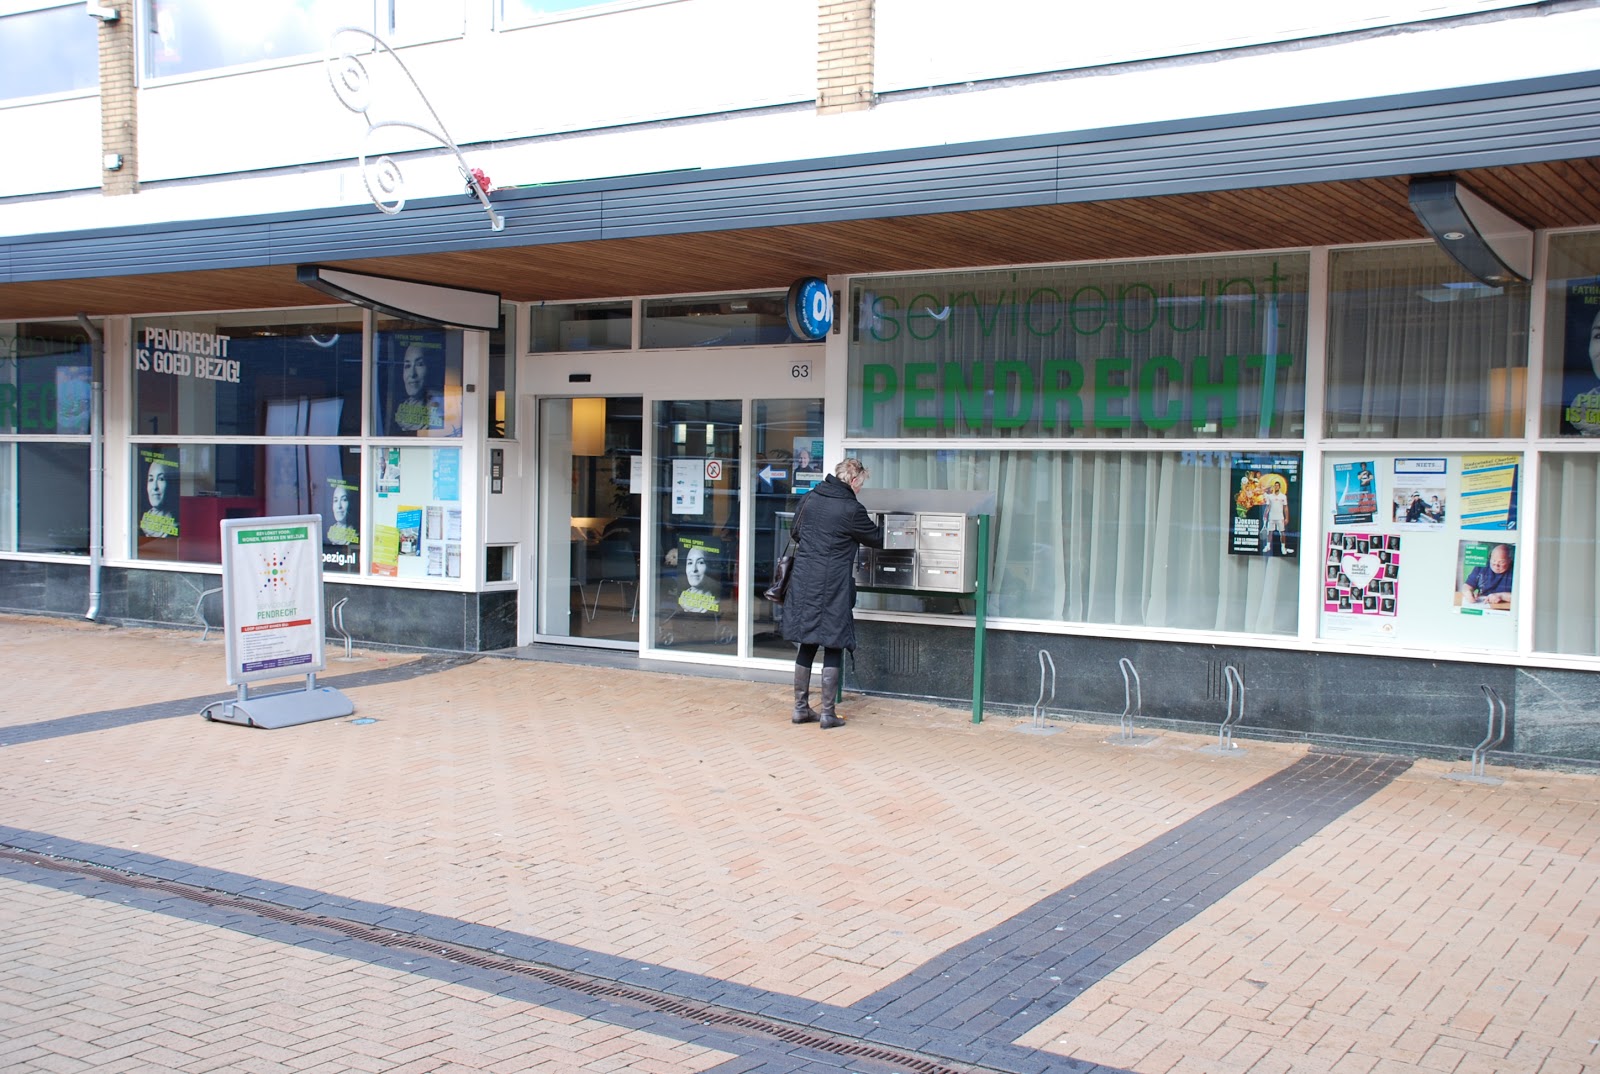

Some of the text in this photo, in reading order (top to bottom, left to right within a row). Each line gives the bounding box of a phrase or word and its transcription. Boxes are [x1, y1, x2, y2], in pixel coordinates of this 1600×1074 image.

[870, 262, 1288, 349] servicepunt
[1584, 296, 1600, 304] ME
[145, 327, 230, 358] PENDRECHT
[136, 349, 240, 383] IS GOED BEZIG!
[791, 365, 808, 378] 63
[861, 354, 1293, 430] PENDRECHT
[1578, 395, 1600, 408] PE
[1565, 407, 1581, 422] IS
[1235, 517, 1259, 525] DJOKOVIC
[257, 608, 297, 619] PENDRECHT
